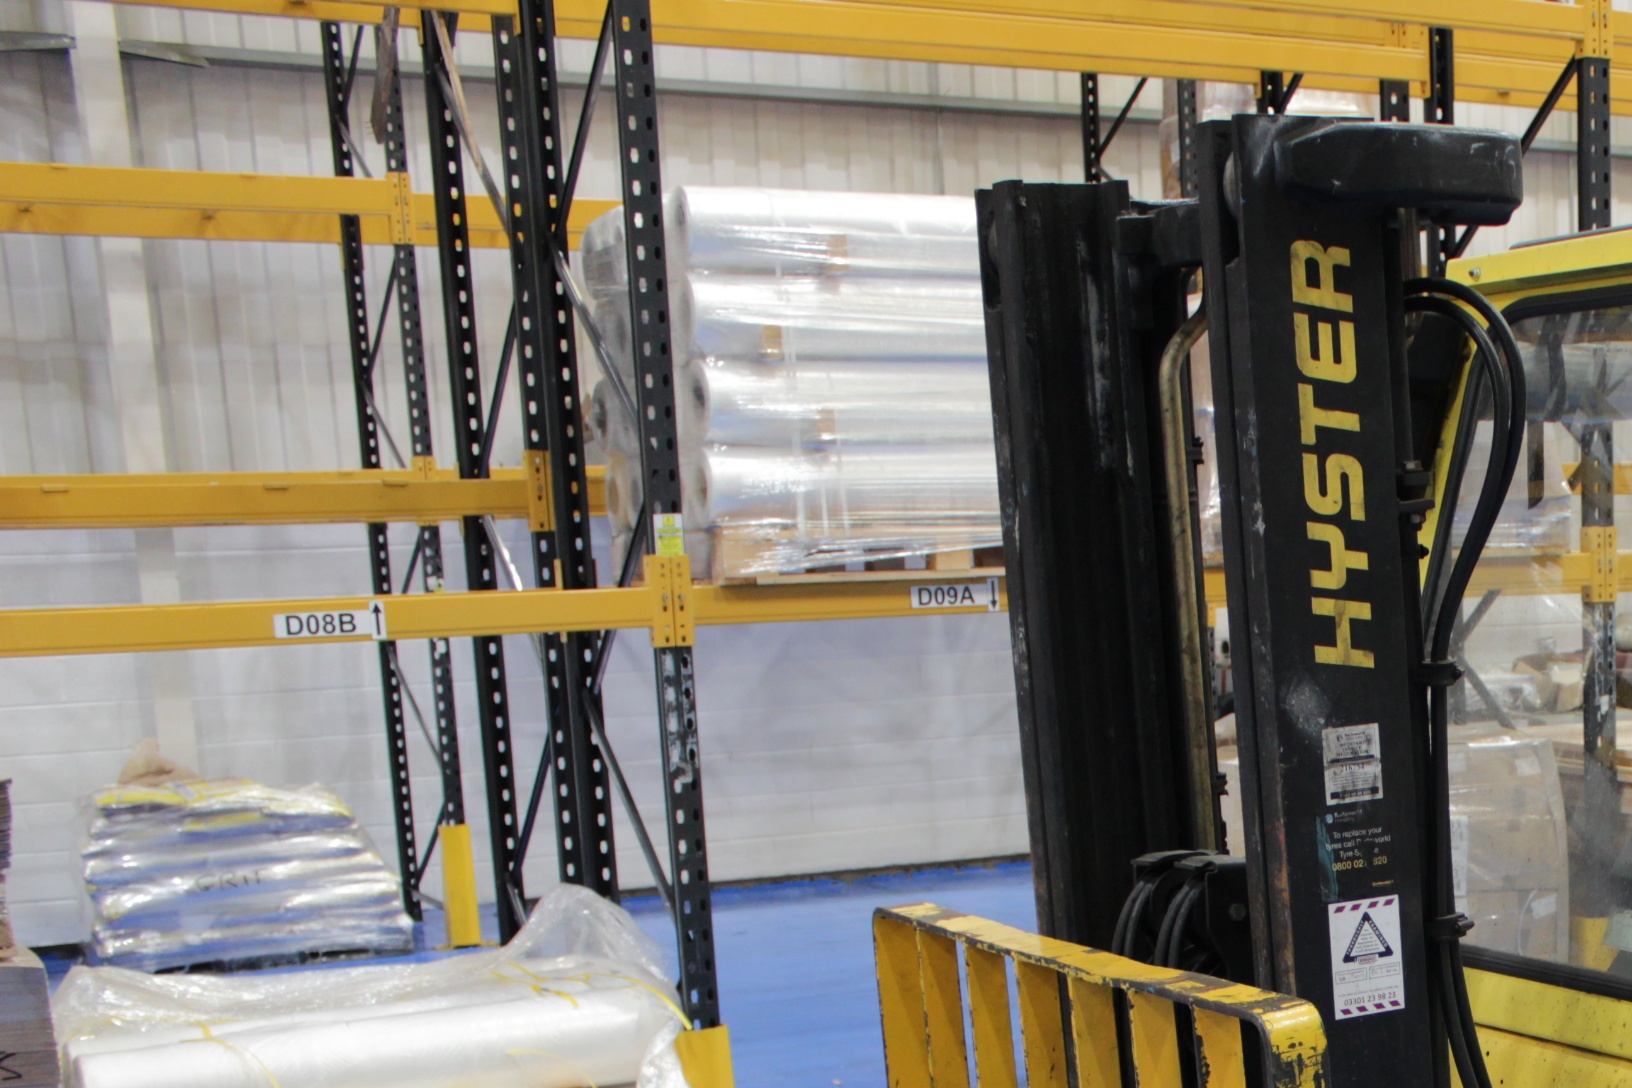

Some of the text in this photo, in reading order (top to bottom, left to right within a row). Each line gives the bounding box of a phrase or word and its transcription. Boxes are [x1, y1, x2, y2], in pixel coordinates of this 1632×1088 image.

[1290, 239, 1375, 668] HYSTER
[917, 585, 975, 606] D09A
[285, 612, 357, 636] D08B
[1333, 826, 1383, 839] To replace your
[1343, 840, 1355, 848] call
[1339, 850, 1353, 859] Tyre
[1331, 860, 1352, 871] 0800
[1353, 858, 1367, 869] 02
[1343, 996, 1366, 1007] 03301
[1367, 994, 1376, 1003] 23
[1377, 992, 1386, 1001] 98
[1387, 991, 1396, 999] 23
